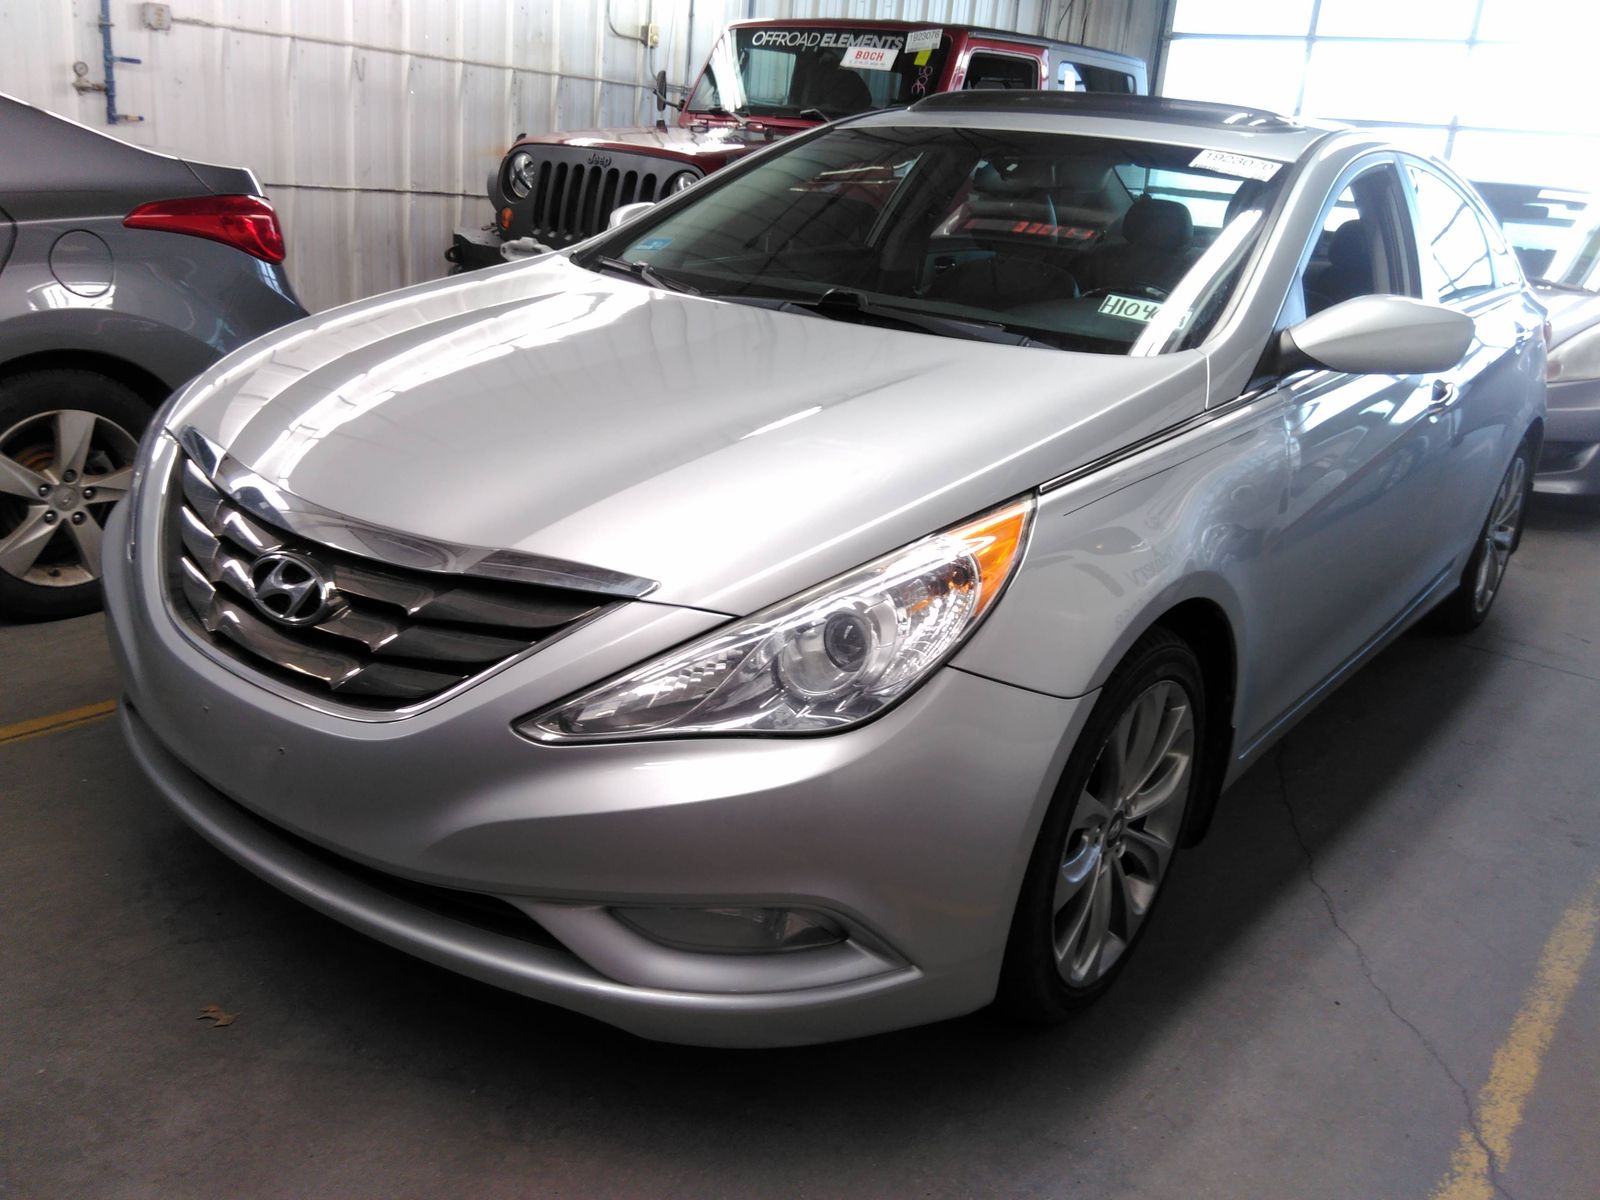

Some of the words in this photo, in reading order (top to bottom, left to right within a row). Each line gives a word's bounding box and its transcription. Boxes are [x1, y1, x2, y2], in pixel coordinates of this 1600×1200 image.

[752, 31, 821, 47] OFFROAD
[820, 33, 904, 50] ELEMENTS
[855, 51, 884, 61] BOCH
